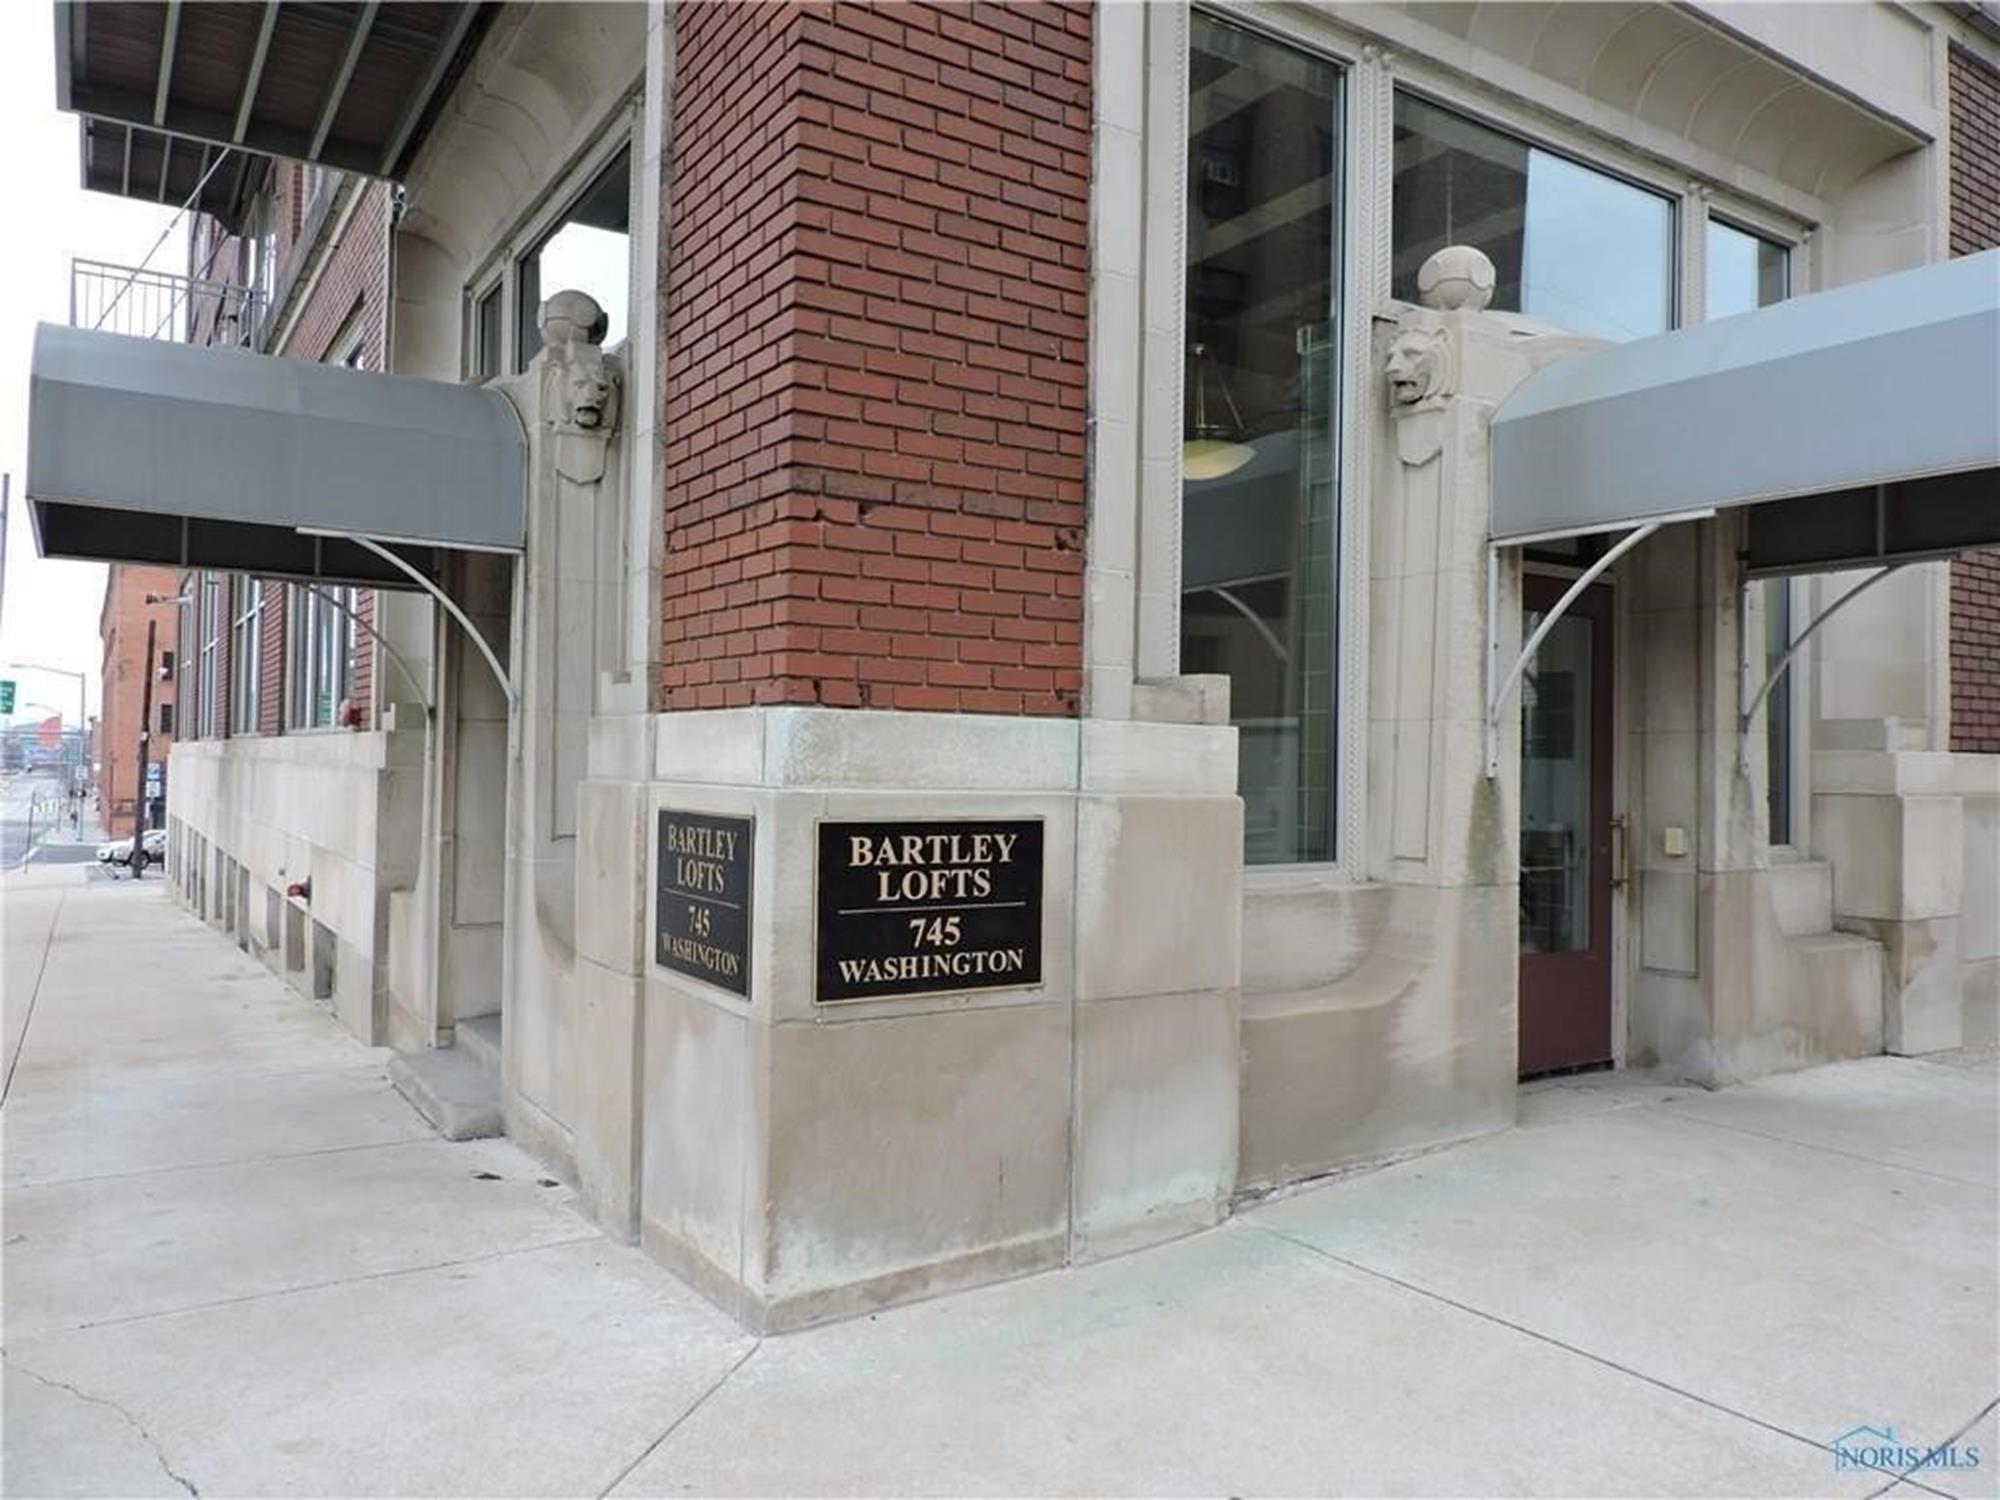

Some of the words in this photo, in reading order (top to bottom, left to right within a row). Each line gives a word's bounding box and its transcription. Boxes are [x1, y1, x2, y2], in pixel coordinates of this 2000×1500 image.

[668, 823, 738, 860] BARTLEY
[849, 834, 1018, 866] BARTLEY
[677, 856, 725, 893] LOFTS
[877, 868, 991, 901] LOFTS
[688, 905, 711, 938] 745
[909, 916, 961, 948] 745
[661, 933, 740, 976] WASHINGTON
[838, 949, 1023, 984] WASHINGTON
